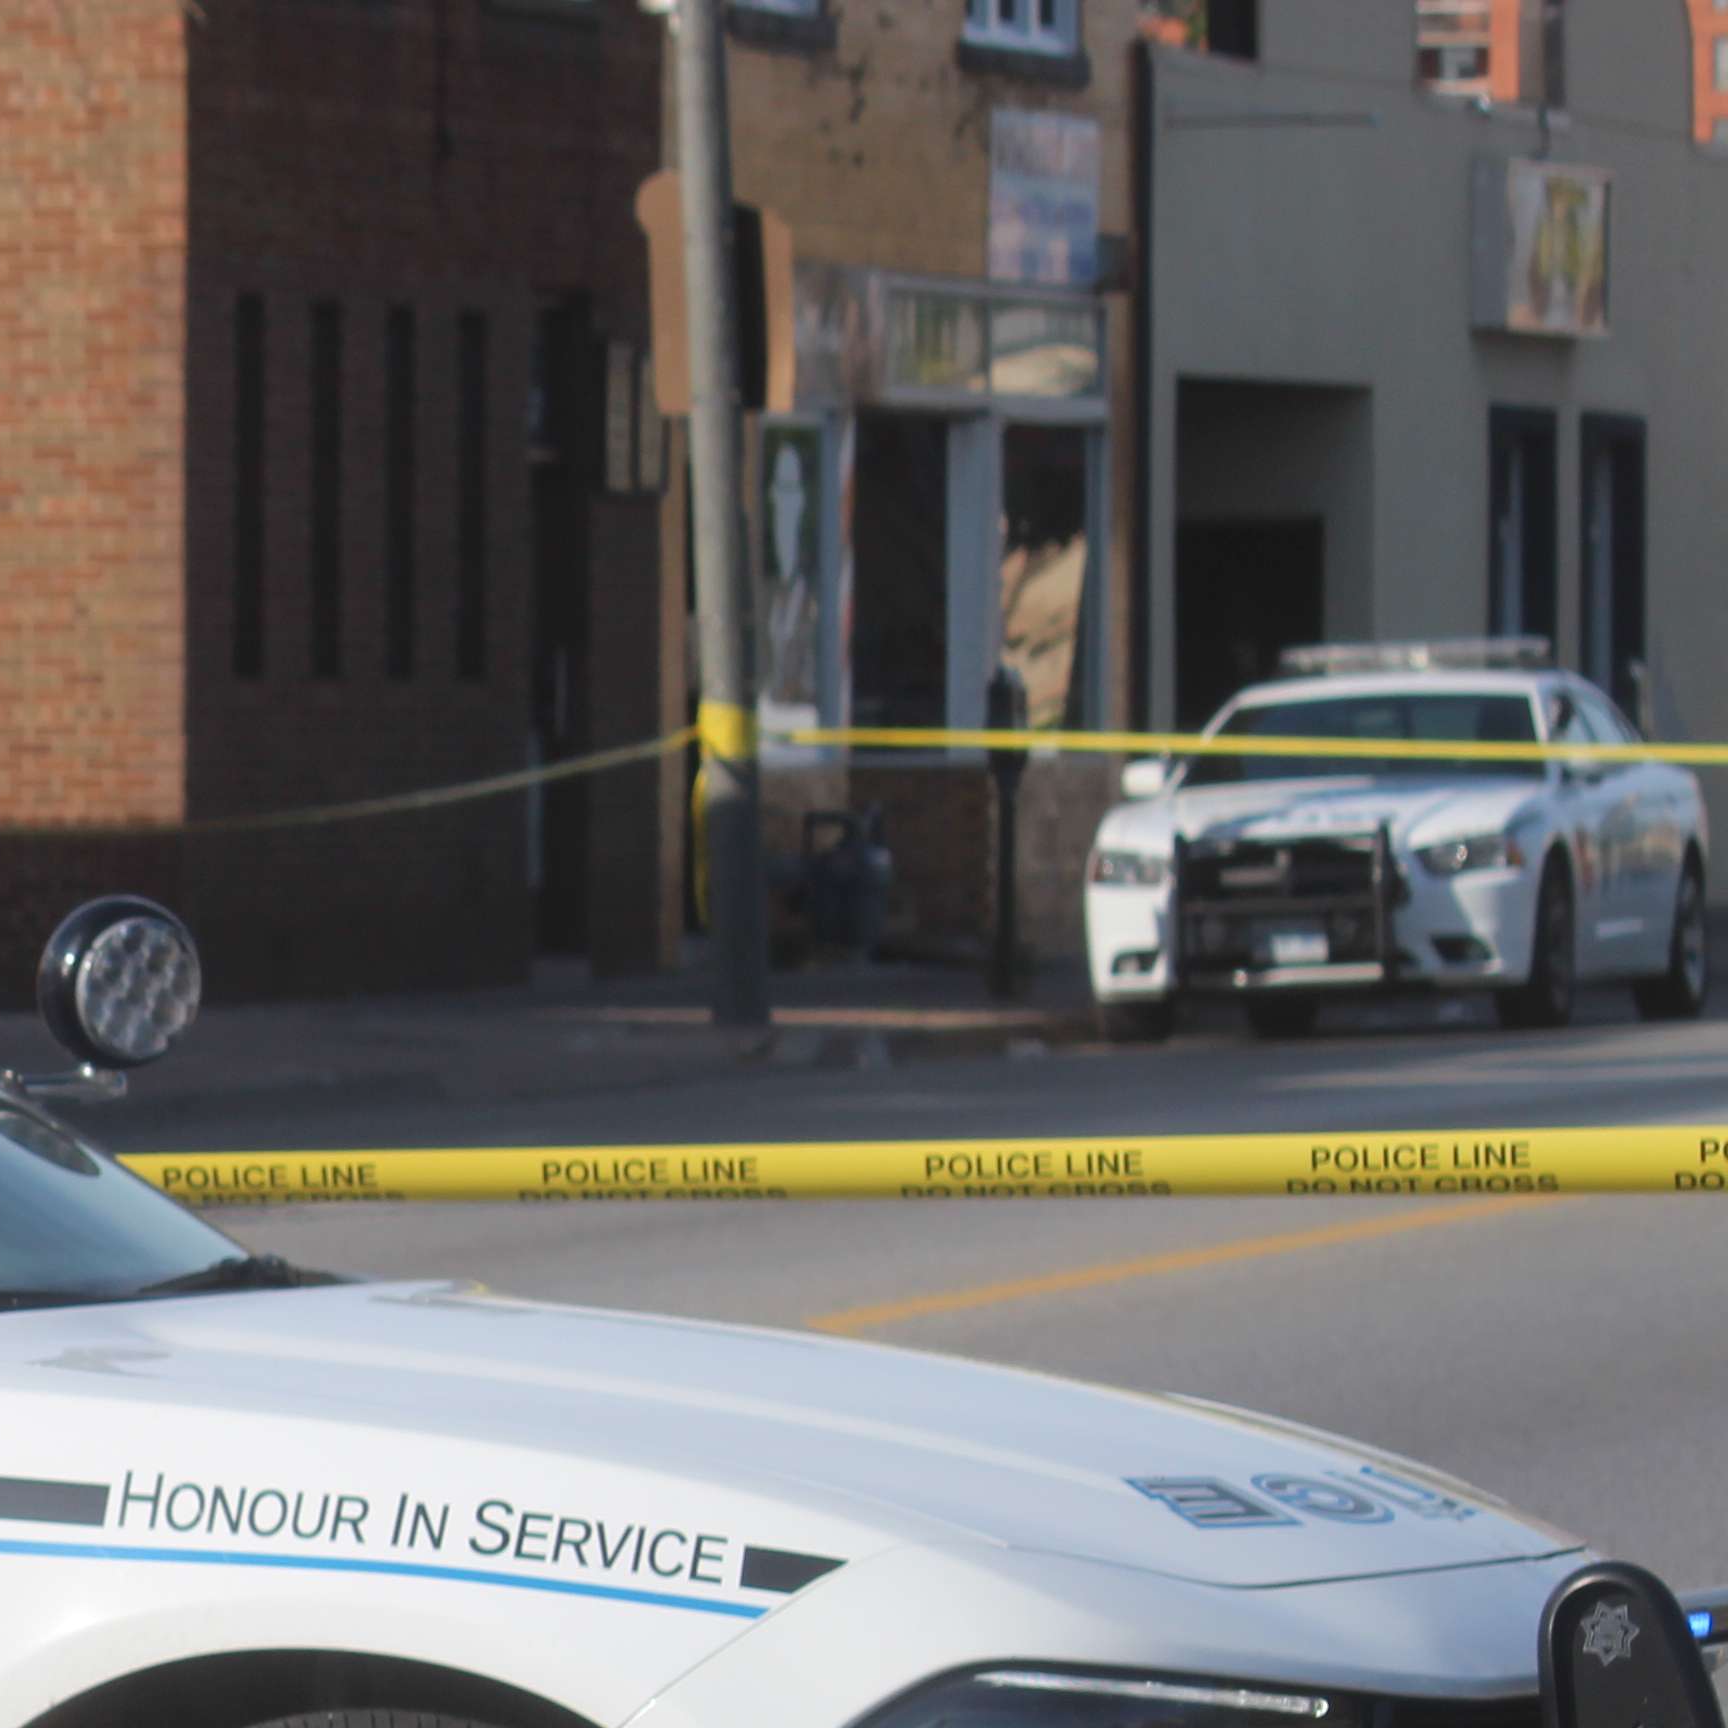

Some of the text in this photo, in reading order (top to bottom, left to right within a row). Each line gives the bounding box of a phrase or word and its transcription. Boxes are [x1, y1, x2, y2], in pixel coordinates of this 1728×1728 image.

[925, 1150, 1143, 1180] POLICE LINE
[1311, 1141, 1531, 1172] POLICE LINE
[162, 1162, 377, 1189] POLICE LINE
[542, 1157, 758, 1185] POLICE LINE
[1286, 1174, 1560, 1194] DO NOT CROSS
[1675, 1171, 1725, 1192] DO
[117, 1470, 729, 1585] HONOUR IN SERVICE
